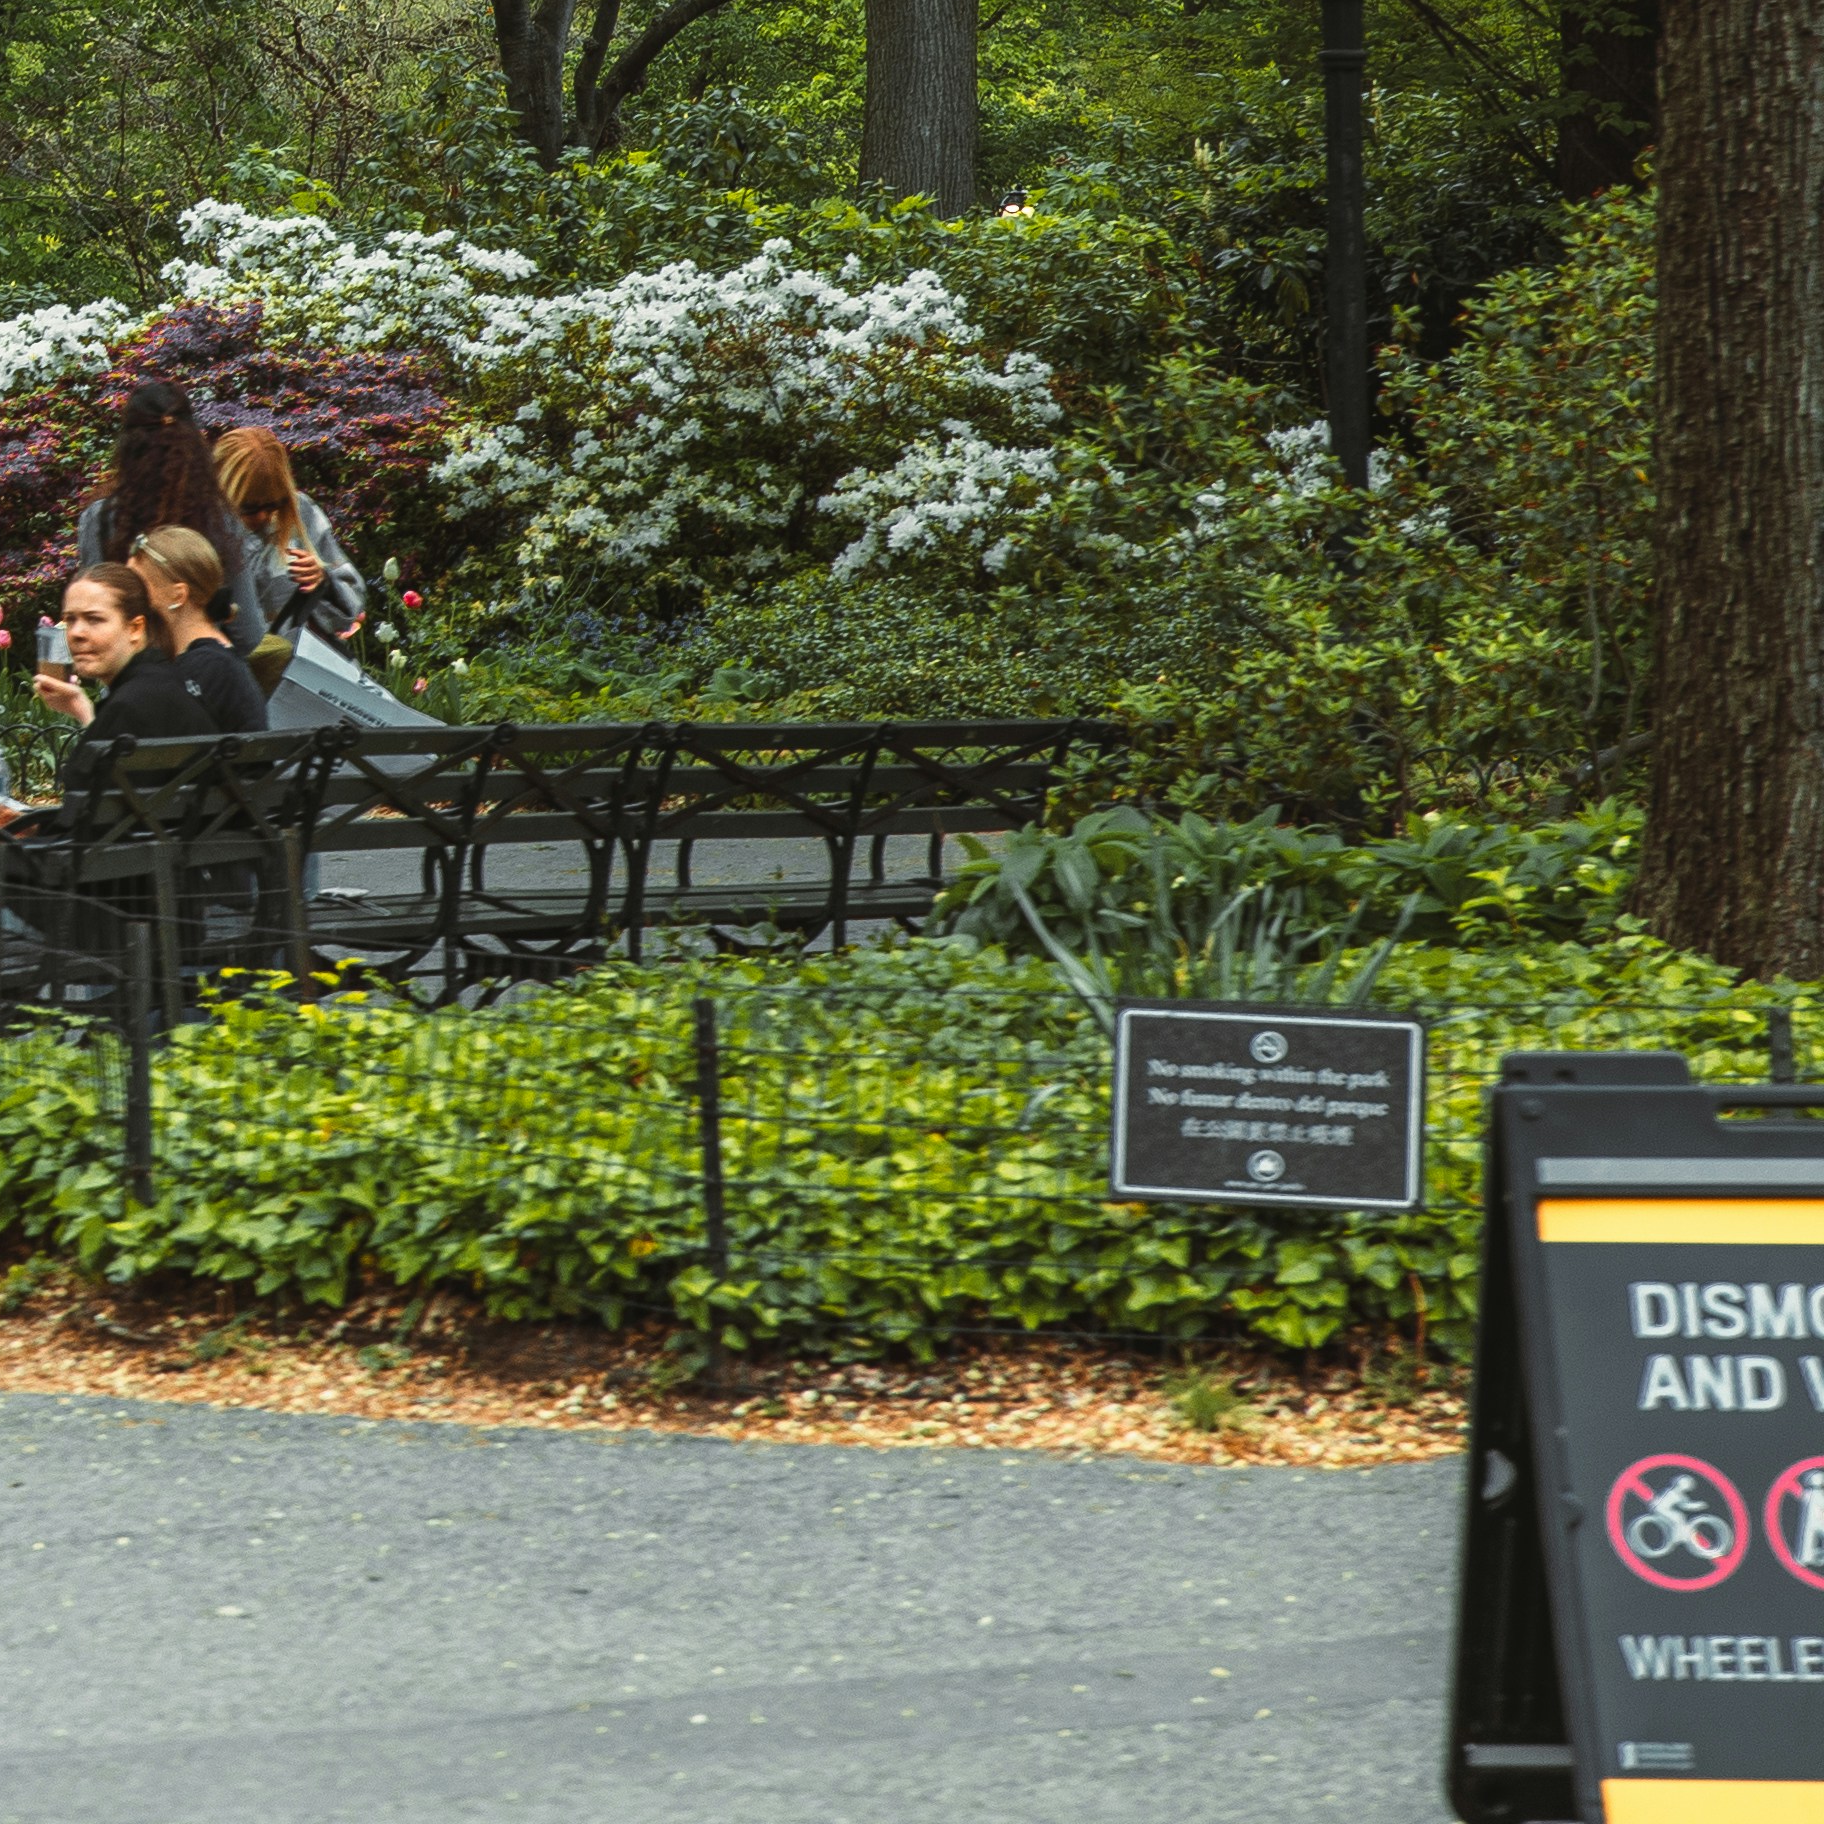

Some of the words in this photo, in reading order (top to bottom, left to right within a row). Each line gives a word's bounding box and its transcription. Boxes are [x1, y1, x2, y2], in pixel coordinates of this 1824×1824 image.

[1147, 1059, 1179, 1077] No
[1180, 1062, 1256, 1085] smoking
[1147, 1087, 1179, 1106] No
[1638, 1353, 1788, 1411] AND
[1619, 1634, 1824, 1682] WHEELE
